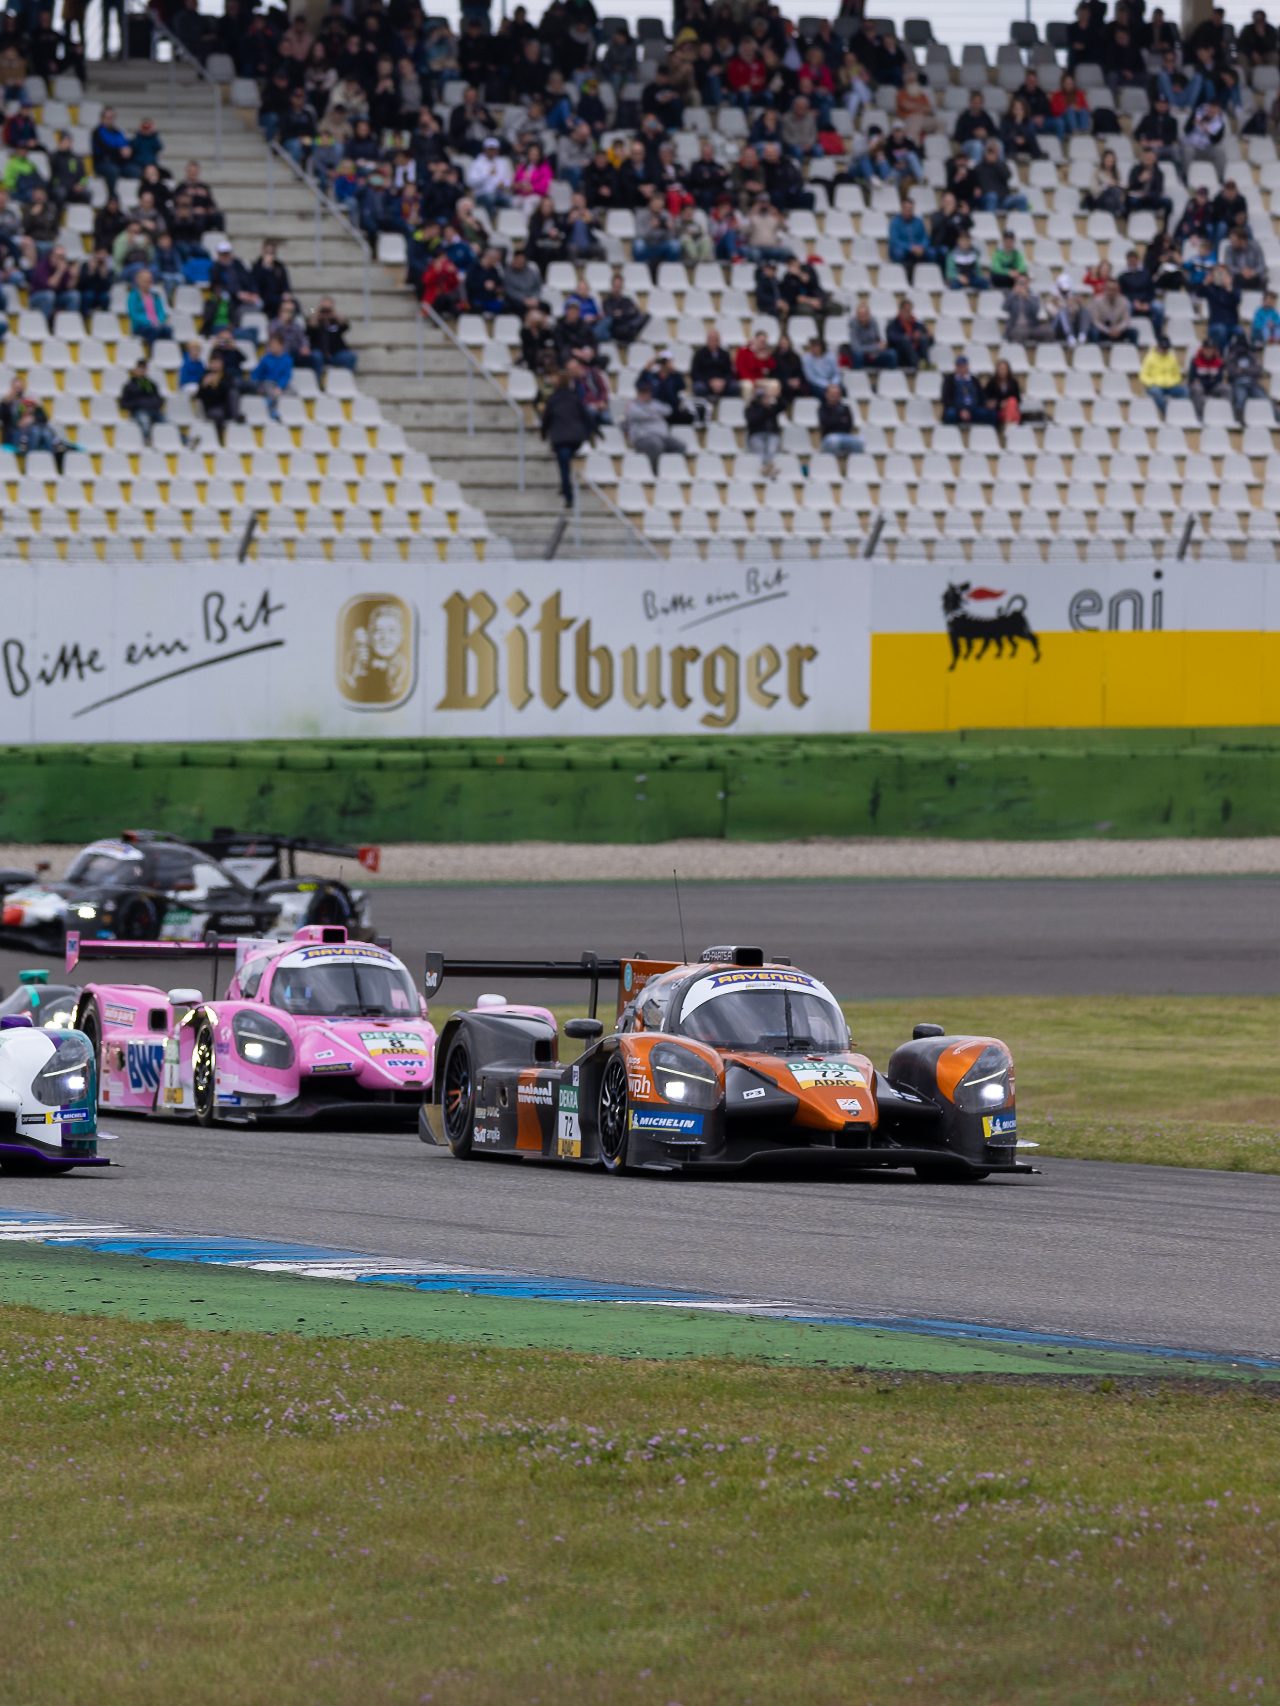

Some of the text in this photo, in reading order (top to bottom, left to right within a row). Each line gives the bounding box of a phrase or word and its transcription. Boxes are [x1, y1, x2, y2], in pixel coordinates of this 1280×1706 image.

[1068, 569, 1163, 632] eni
[2, 588, 286, 697] Bitte ein Bit
[434, 588, 819, 729] Bitburger
[307, 948, 388, 959] RAVENOL
[718, 972, 809, 985] RAVENOL
[361, 1031, 421, 1040] DEKRA
[788, 1062, 857, 1072] DEKRA
[815, 1070, 848, 1079] 72
[814, 1079, 857, 1088] ADAC
[559, 1089, 579, 1109] DEKRA
[564, 1115, 574, 1137] 72
[639, 1116, 695, 1128] MICHELIN
